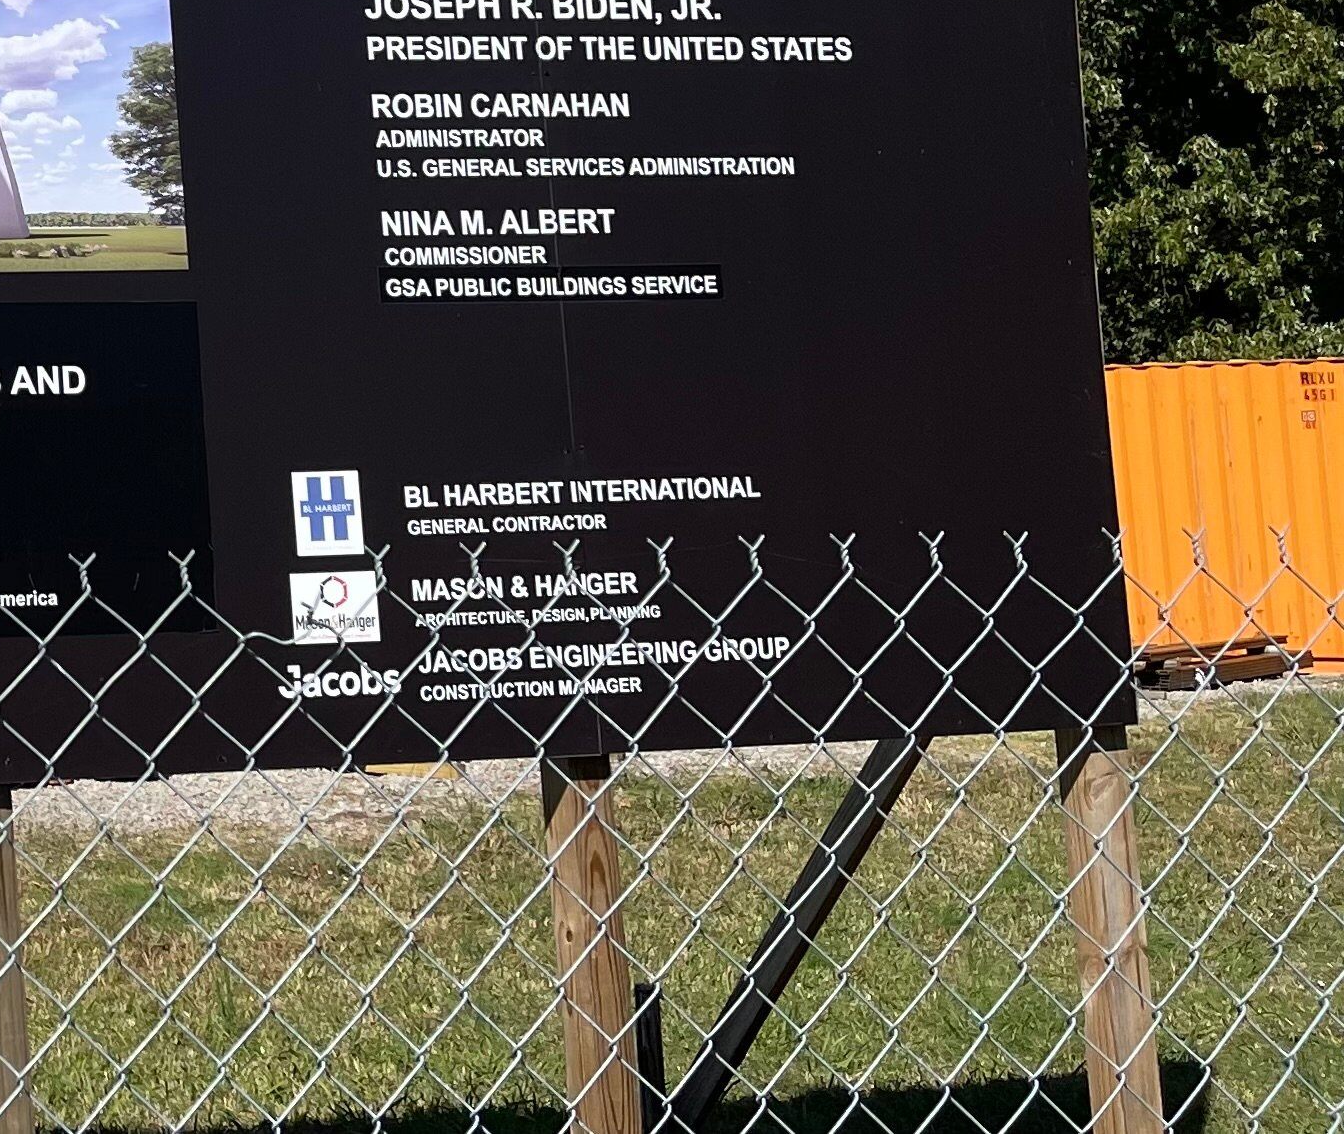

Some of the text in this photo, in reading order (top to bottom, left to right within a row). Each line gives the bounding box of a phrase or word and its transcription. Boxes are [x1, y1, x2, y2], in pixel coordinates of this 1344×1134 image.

[366, 35, 853, 62] PRESIDENT OF THE UNITED STATES
[370, 92, 631, 119] ROBIN CARNAHAN
[375, 128, 546, 149] ADMINISTRATOR
[376, 156, 795, 178] U.S. GENERAL SERVICES ADMINISTRATION
[380, 208, 616, 237] NINA M. ALBERT
[384, 245, 548, 267] COMMISSIONER
[385, 274, 719, 298] GSA PUBLIC BUILDINGS SERVICE
[10, 365, 86, 395] AND
[403, 475, 762, 509] BL HARBERT INTERNATIONAL
[302, 503, 352, 514] BL HARBERT
[406, 513, 608, 536] GENERAL CONTRACTOR
[412, 571, 639, 601] MASON & HANGER
[418, 636, 790, 674] JACOBS ENGINEERING GROUP
[278, 662, 402, 699] Jacobs
